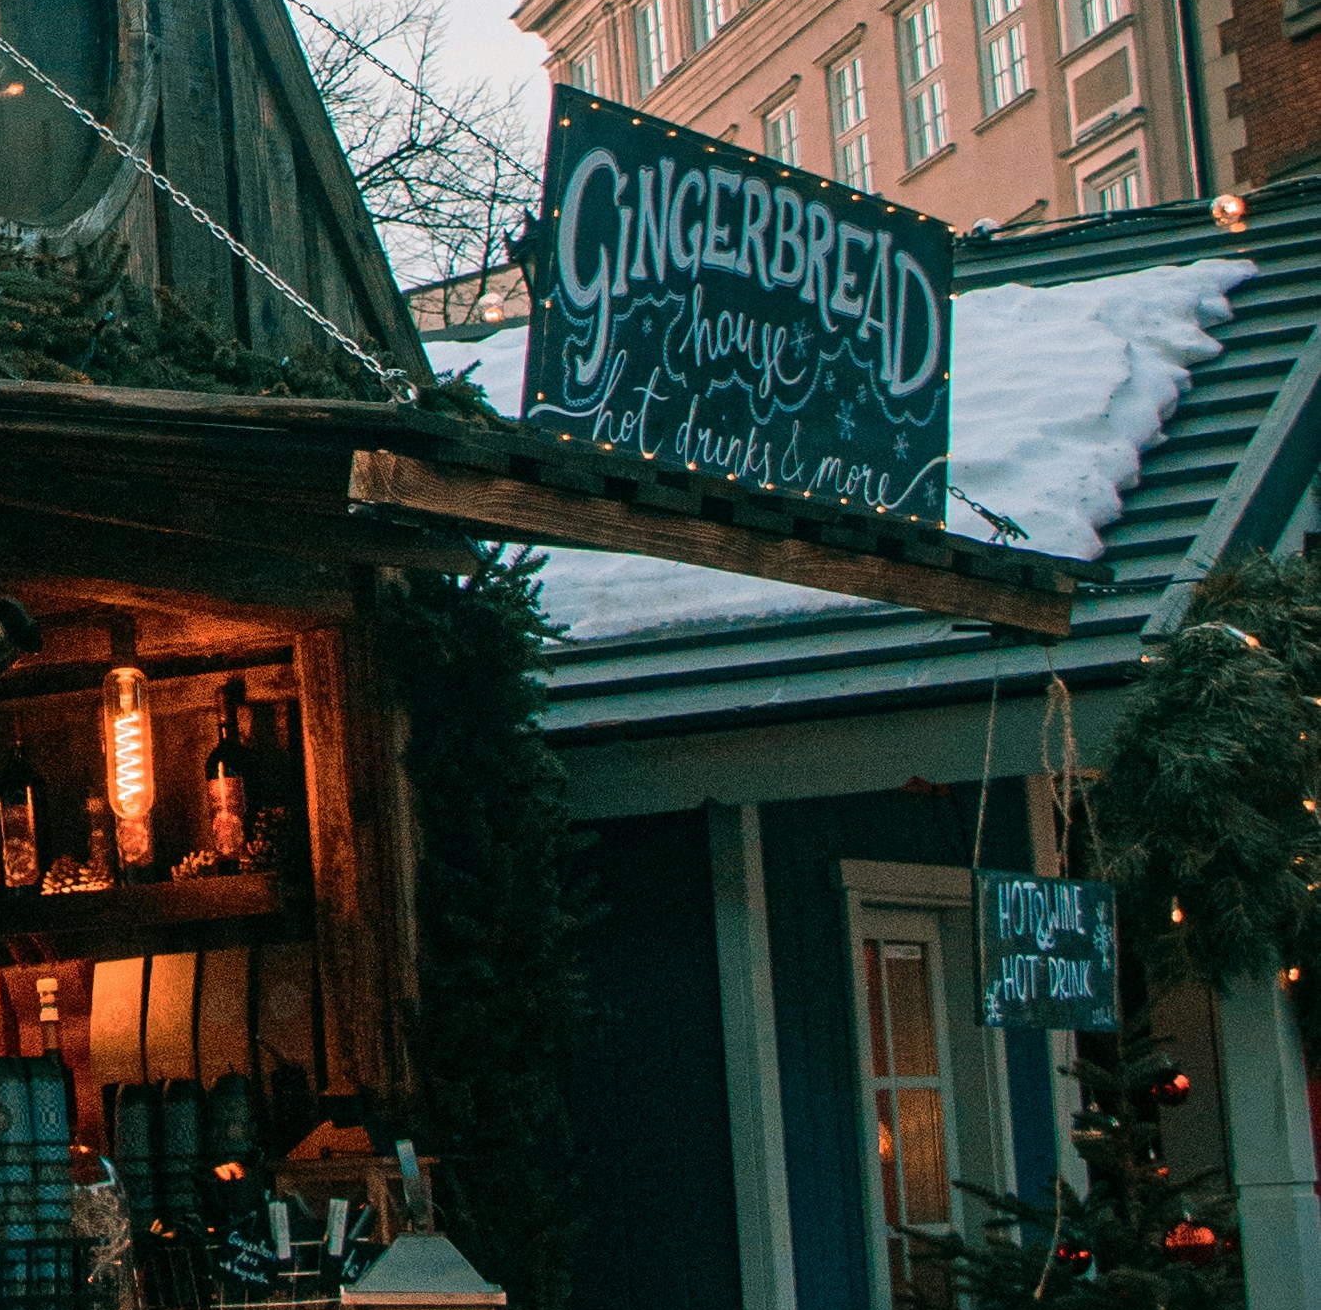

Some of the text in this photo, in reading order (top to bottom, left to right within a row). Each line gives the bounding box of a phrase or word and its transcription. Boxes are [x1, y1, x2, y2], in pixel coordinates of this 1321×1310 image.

[558, 148, 941, 397] GINGERBREAD
[679, 283, 808, 399] house
[529, 350, 949, 510] hot drinks & more
[998, 880, 1037, 939] HOT
[1044, 883, 1086, 935] WINE
[1002, 953, 1093, 1002] HOT DRINK
